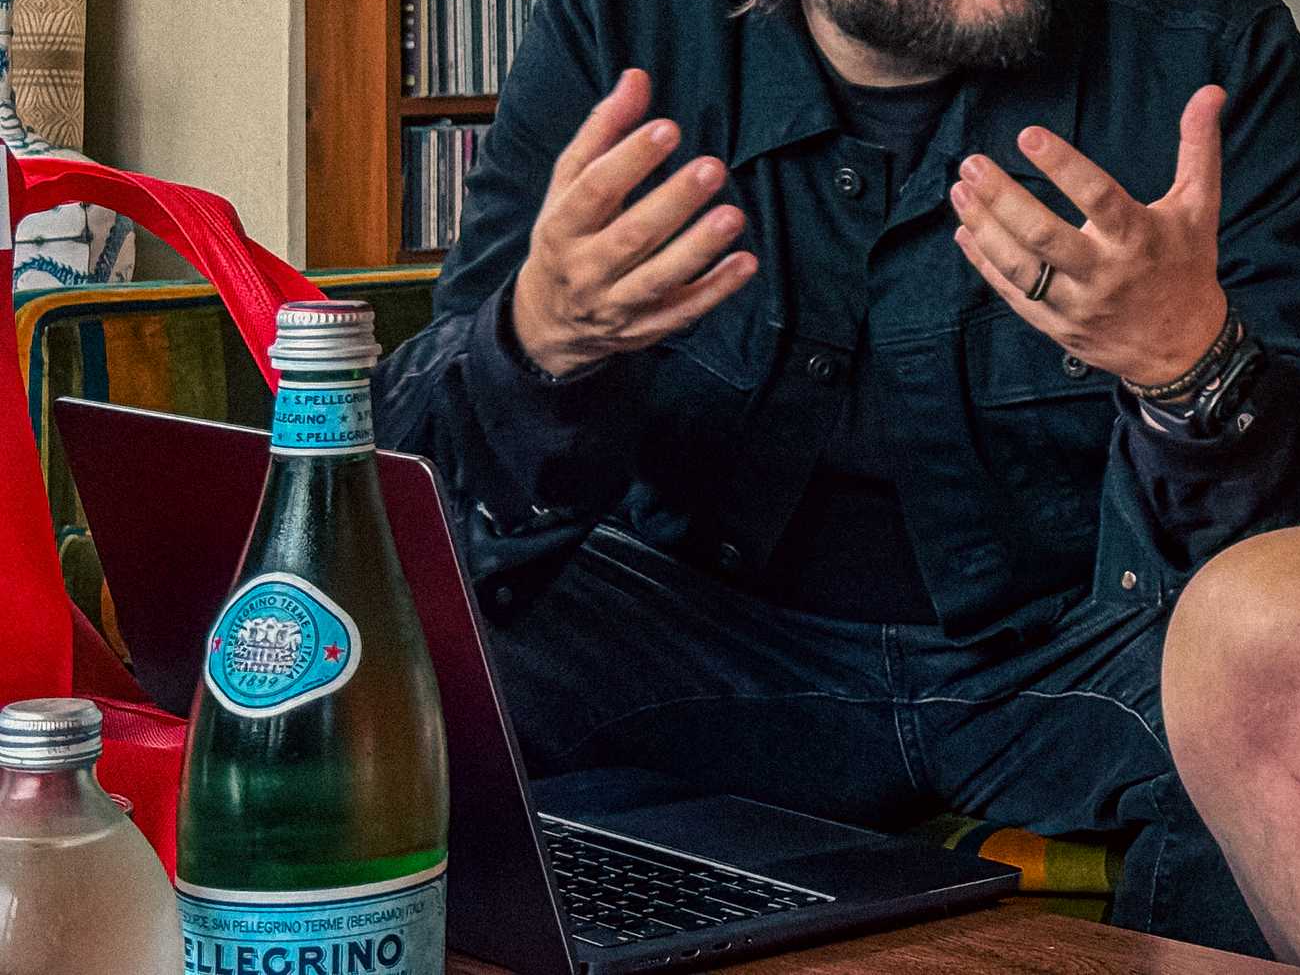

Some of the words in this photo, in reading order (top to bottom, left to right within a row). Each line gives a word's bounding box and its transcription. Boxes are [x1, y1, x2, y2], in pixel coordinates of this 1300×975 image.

[294, 392, 369, 405] S.PELLEGR
[280, 598, 311, 629] TERME
[286, 646, 312, 680] ITALIA
[213, 918, 231, 932] SAN
[232, 920, 301, 934] PELLEGRINO
[305, 917, 343, 933] TERME
